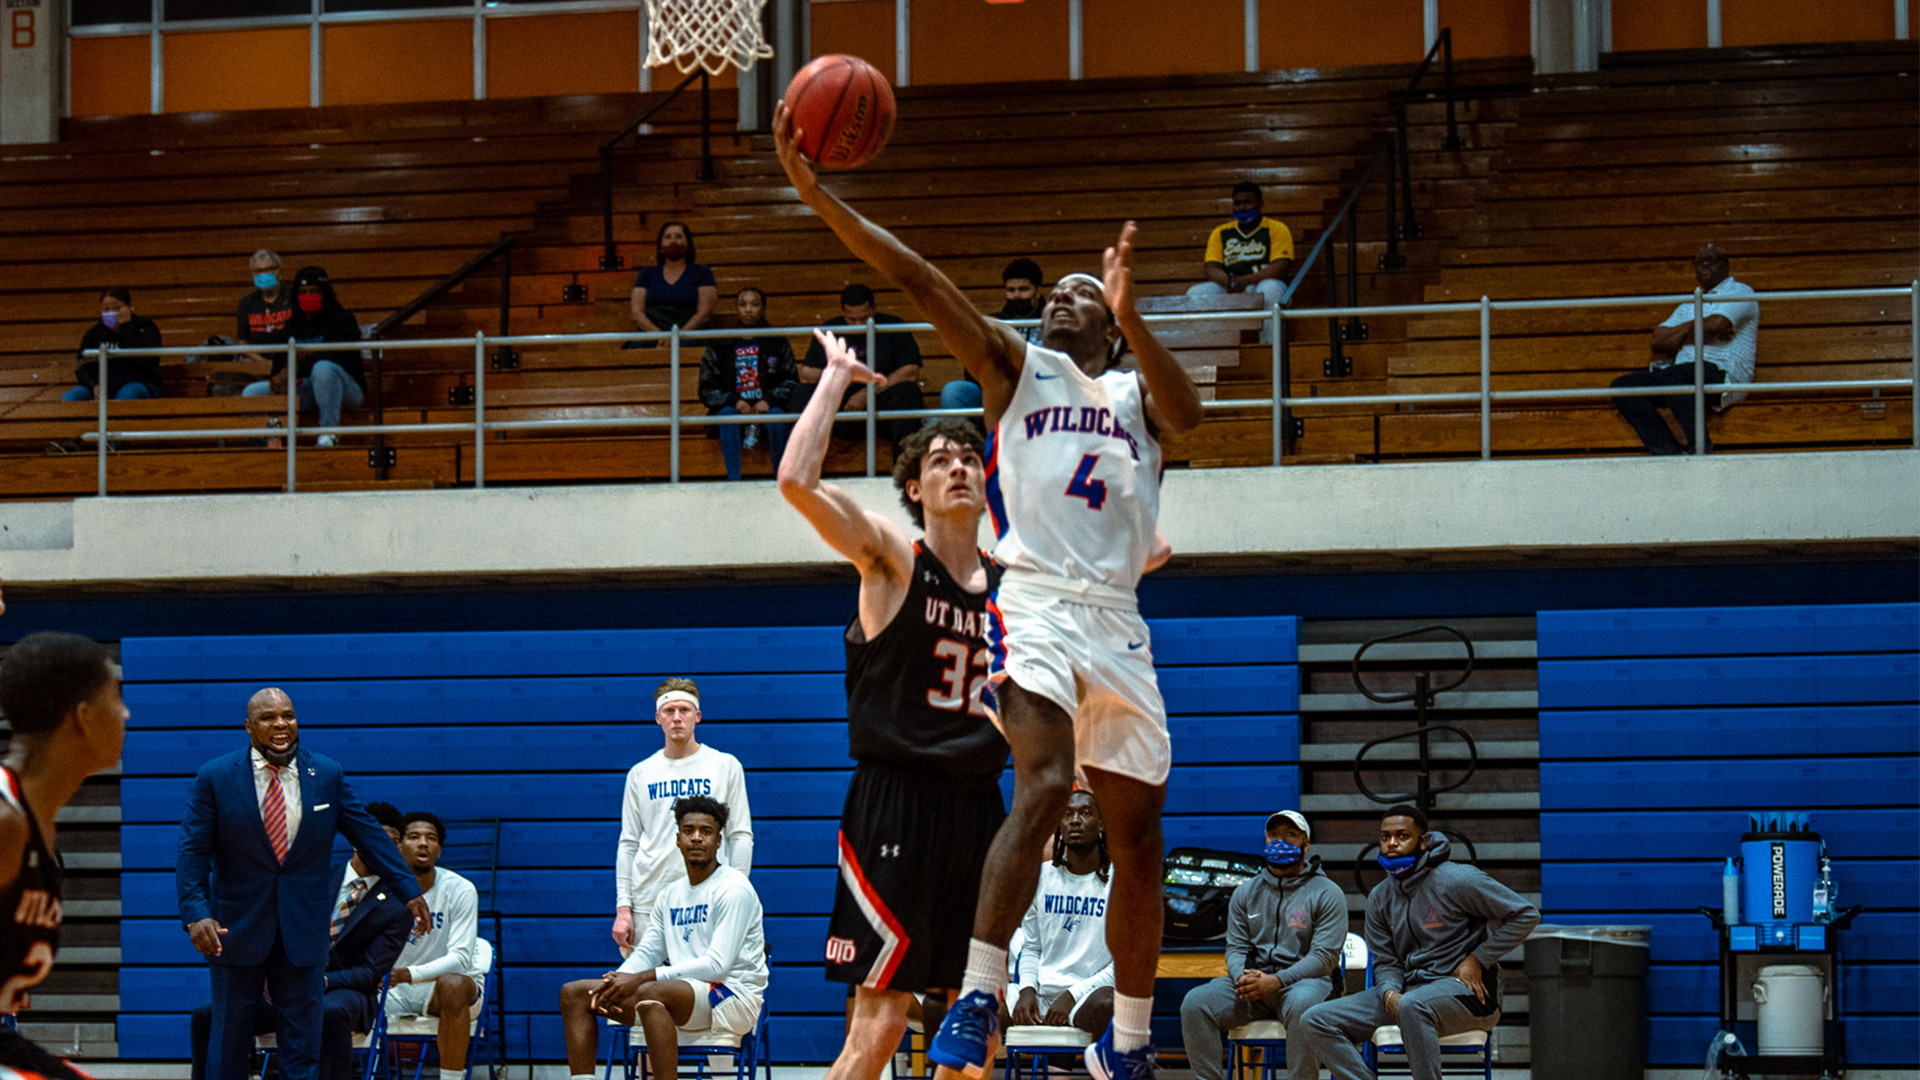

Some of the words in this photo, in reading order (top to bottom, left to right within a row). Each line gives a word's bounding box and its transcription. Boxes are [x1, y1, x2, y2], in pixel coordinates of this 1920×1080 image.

[11, 10, 35, 49] B
[829, 95, 867, 161] Wilson
[1024, 406, 1141, 462] WILDCA
[1064, 453, 1107, 511] 4
[925, 597, 950, 627] UT
[647, 778, 711, 800] WILDCATS
[1772, 846, 1785, 915] POWERADE
[1045, 894, 1105, 917] WILDCATS
[825, 935, 857, 964] UTD
